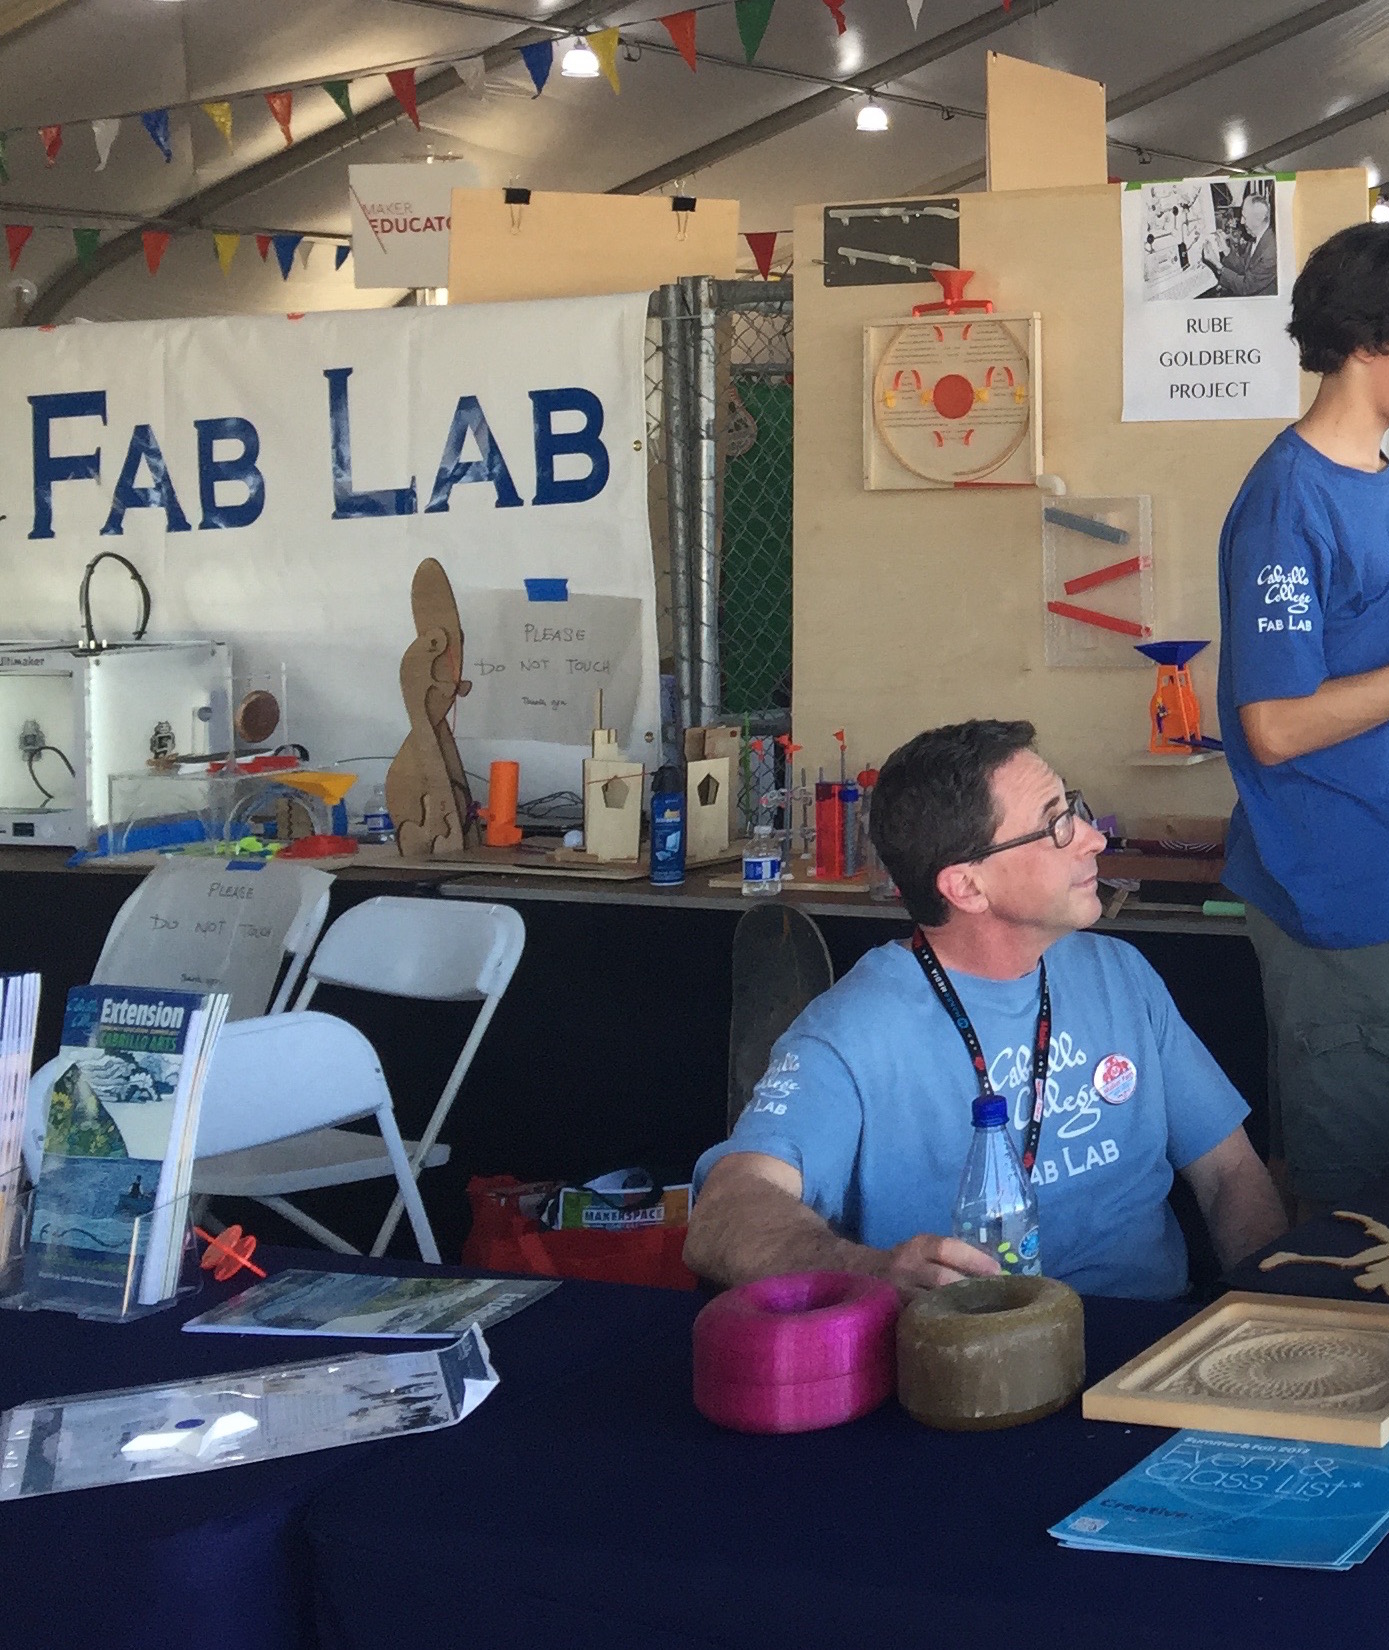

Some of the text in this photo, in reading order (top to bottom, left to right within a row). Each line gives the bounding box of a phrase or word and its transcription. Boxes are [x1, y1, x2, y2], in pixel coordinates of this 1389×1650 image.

[360, 202, 413, 215] MAKER
[1186, 316, 1233, 334] RUBE
[1159, 348, 1261, 368] GOLDBERG
[1169, 381, 1251, 399] PROJECT
[1257, 564, 1310, 586] Cabrillo
[1264, 584, 1313, 615] College
[524, 622, 587, 643] PLEASE
[1257, 615, 1313, 633] FAB LAB
[520, 659, 551, 672] NOT
[565, 658, 612, 675] TOUCH
[207, 881, 255, 900] PLEASE
[100, 997, 185, 1029] Extension
[988, 1031, 1088, 1092] Cabllo
[753, 1099, 788, 1116] LAB
[1013, 1077, 1102, 1139] Clege
[1030, 1138, 1121, 1187] AB LAB
[1161, 1443, 1293, 1472] Event
[1145, 1459, 1269, 1490] Class
